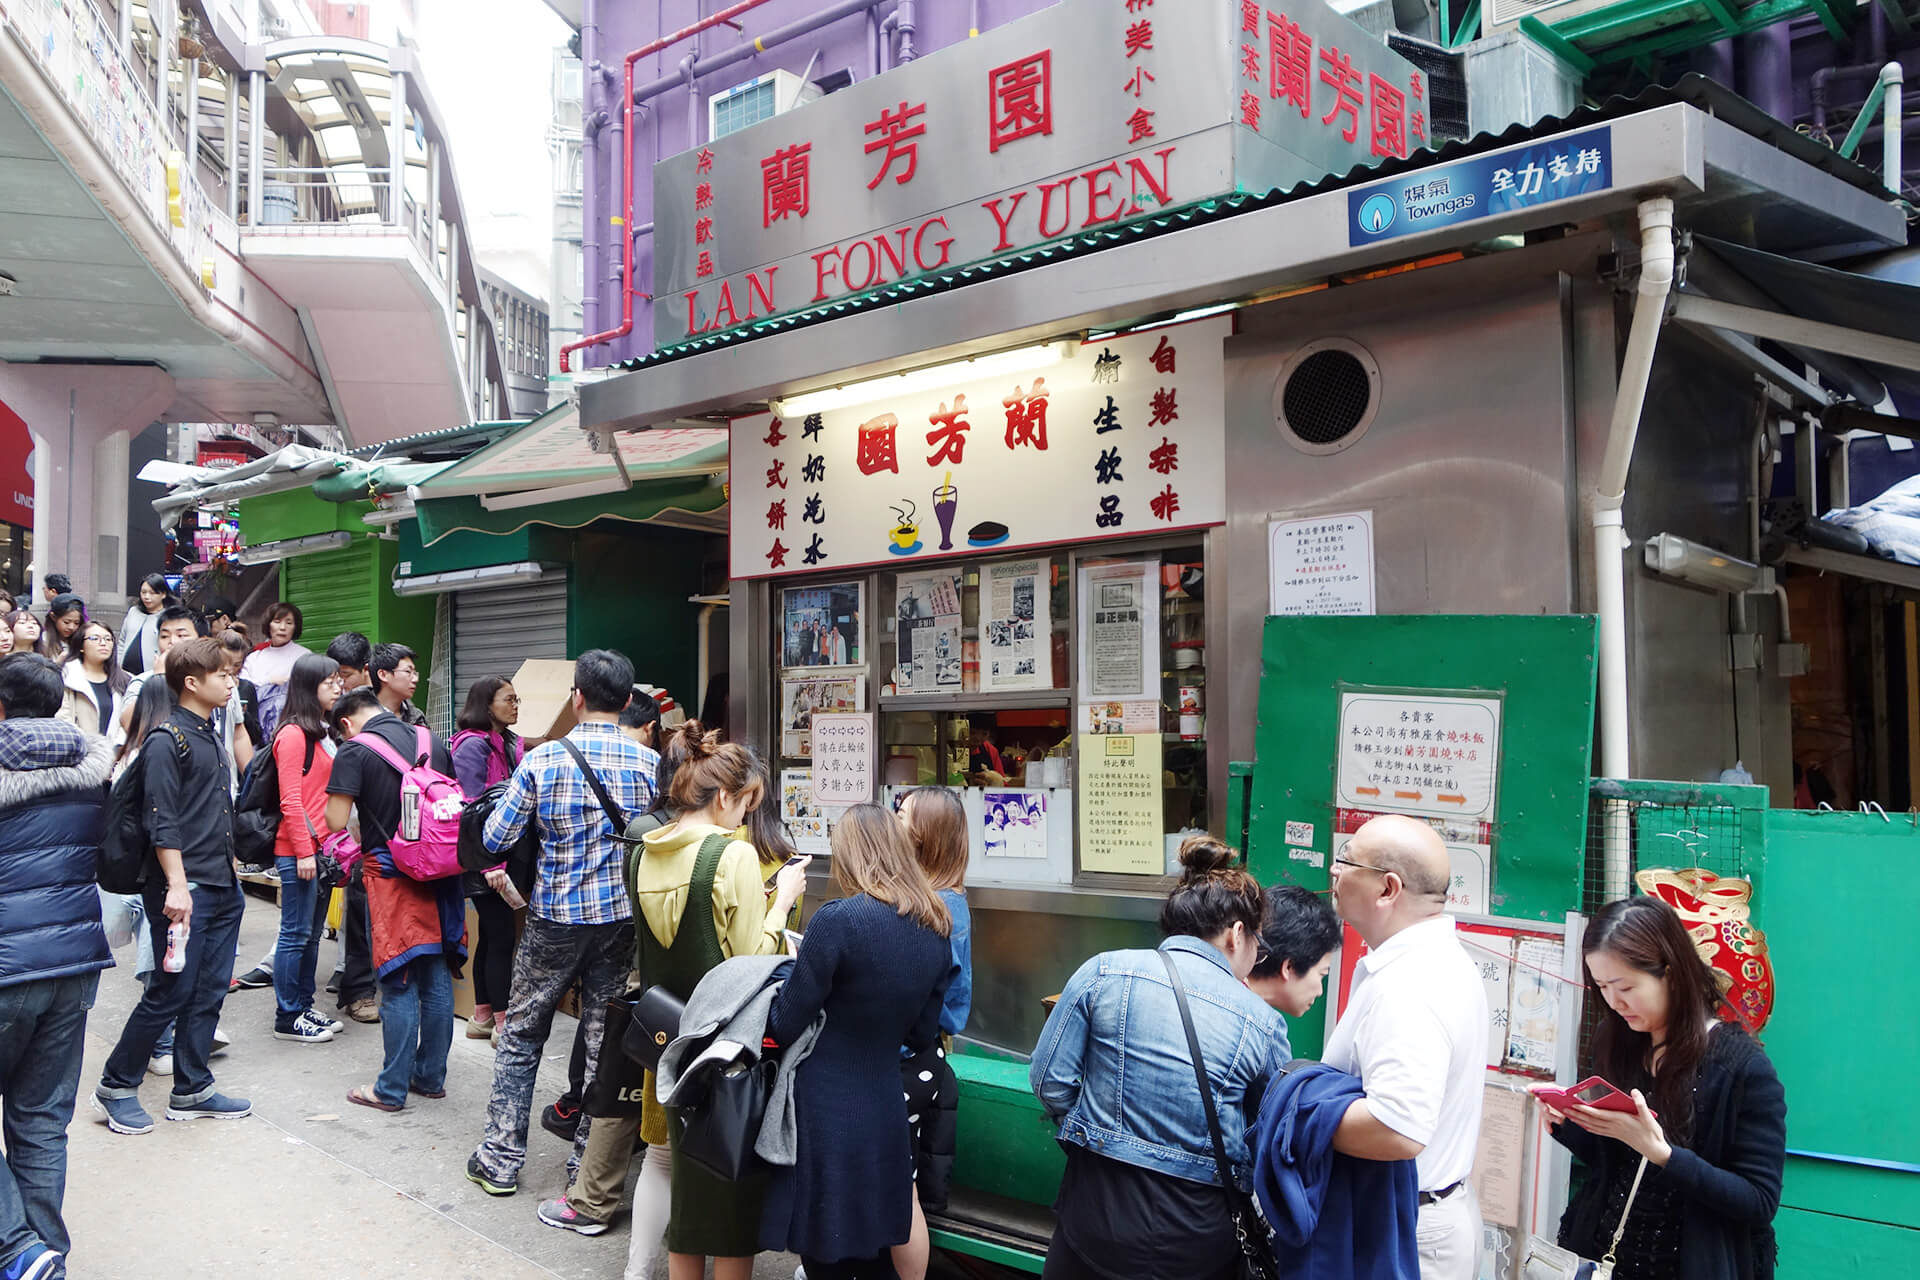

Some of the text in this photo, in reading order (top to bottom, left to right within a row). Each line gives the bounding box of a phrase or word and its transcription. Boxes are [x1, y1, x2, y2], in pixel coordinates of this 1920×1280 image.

[1266, 8, 1407, 158] 蘭芳園
[760, 49, 1053, 229] 蘭芳園
[1491, 148, 1601, 196] 全力支持
[1404, 177, 1450, 204] 煤氣
[696, 146, 714, 279] 冷熱飲品
[1406, 193, 1475, 221] Towngas
[684, 146, 1176, 338] LAN FONG YUEN
[1400, 711, 1435, 723] 各貴客
[819, 741, 866, 755] 請在此輪候
[819, 777, 866, 793] 多謝合作
[1482, 961, 1500, 982] 號
[1492, 1007, 1509, 1028] 茶
